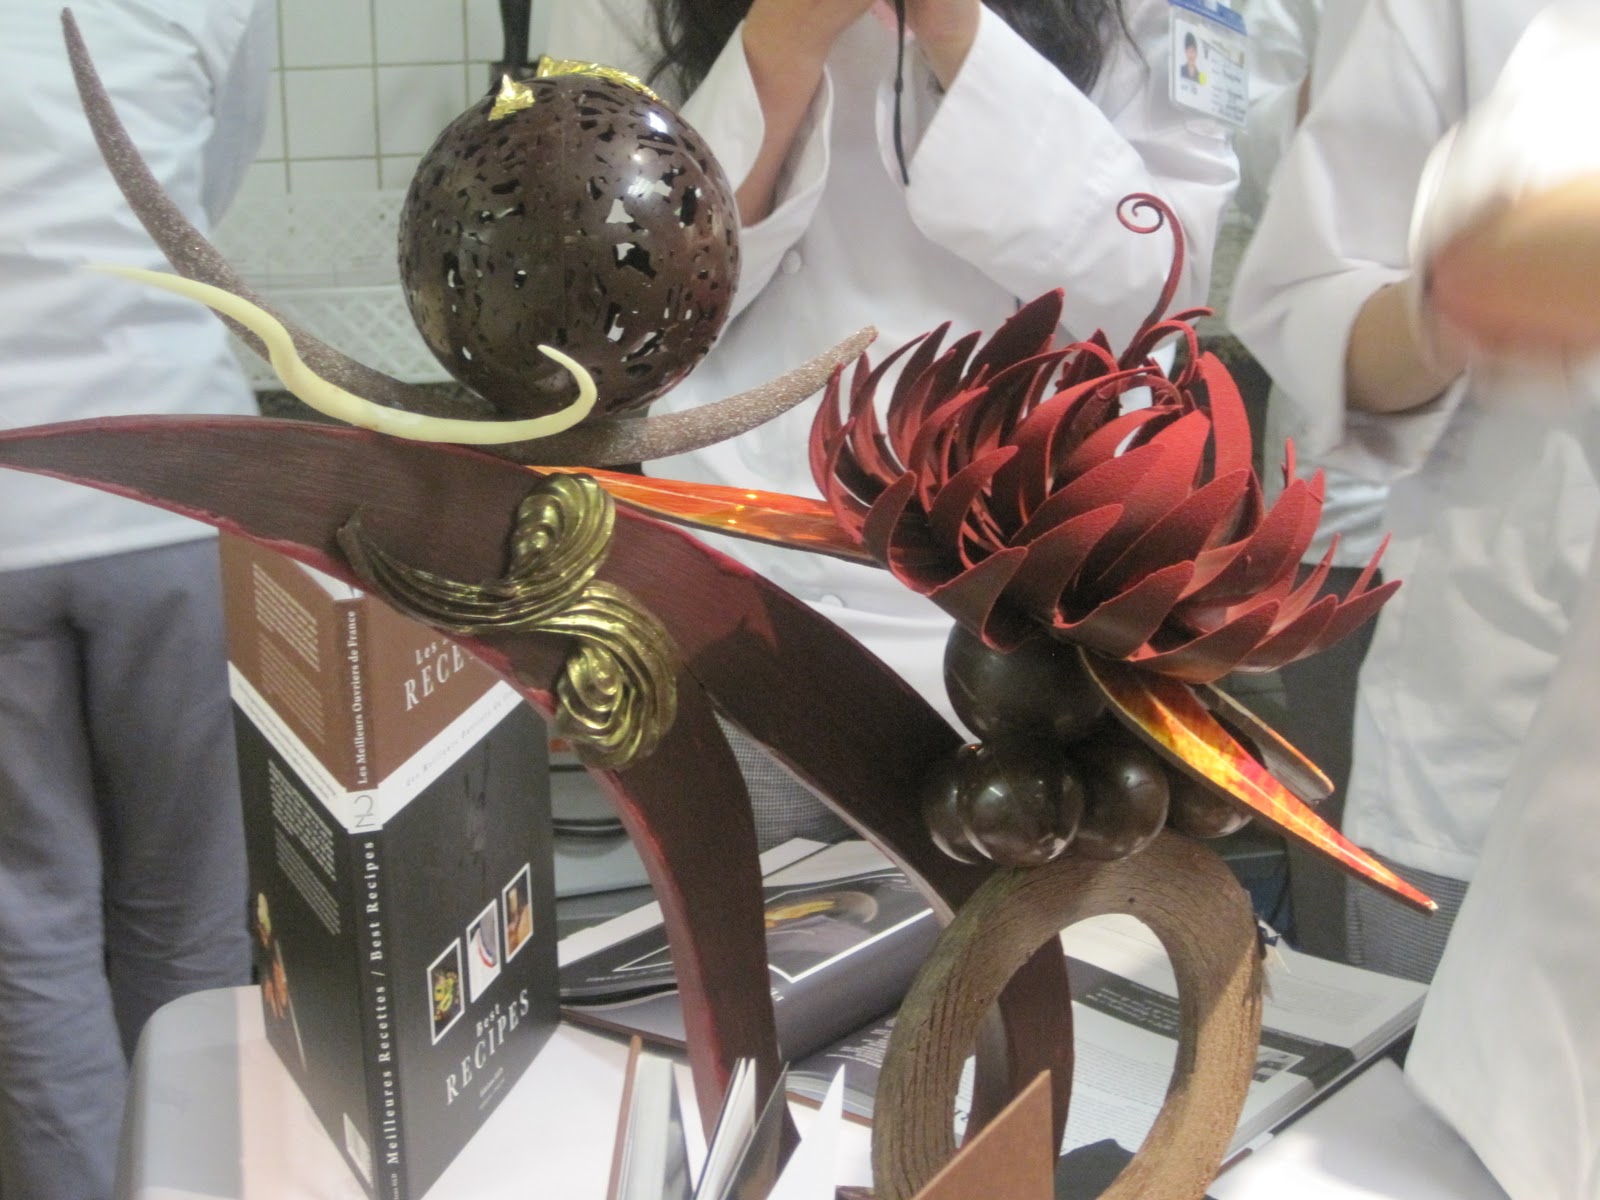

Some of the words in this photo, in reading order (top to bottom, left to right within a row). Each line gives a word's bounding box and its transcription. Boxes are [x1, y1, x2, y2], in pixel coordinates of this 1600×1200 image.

[347, 611, 358, 648] France
[415, 641, 437, 665] Les
[347, 649, 359, 660] de
[404, 645, 470, 711] RECE
[350, 664, 363, 712] Ouvriers
[354, 713, 367, 764] Meilleurs
[357, 766, 368, 785] Les
[364, 842, 379, 913] Recipes
[369, 922, 383, 961] Best
[375, 986, 391, 1063] Recettes
[476, 1003, 500, 1038] Best
[446, 988, 529, 1106] RECIPES
[382, 1070, 399, 1164] Meilleures
